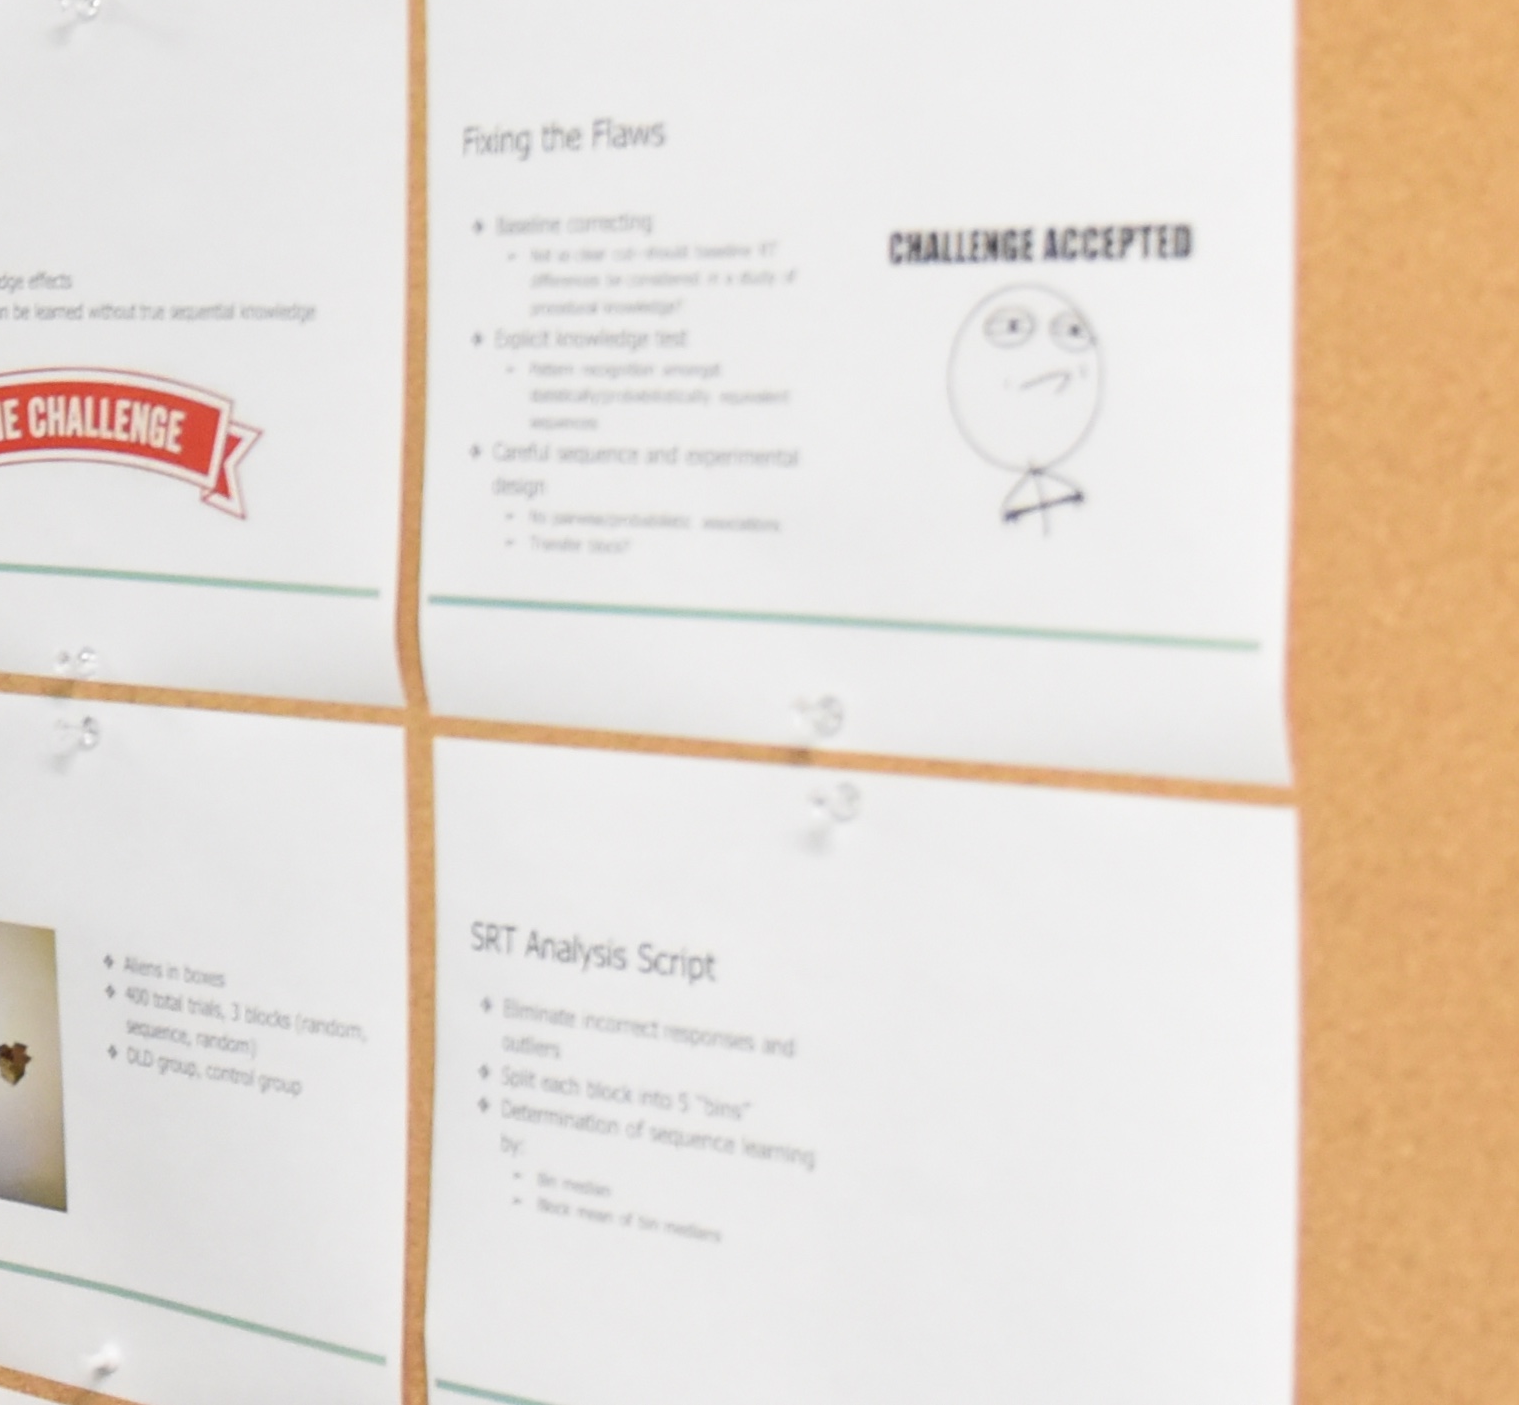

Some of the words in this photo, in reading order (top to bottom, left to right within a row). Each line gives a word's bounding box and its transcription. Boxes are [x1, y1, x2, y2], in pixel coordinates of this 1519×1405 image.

[462, 126, 533, 161] Fixing
[541, 122, 584, 153] the
[591, 117, 667, 149] Flaws
[888, 228, 1034, 265] CHALLENGE
[1042, 224, 1193, 262] ACCEPTED
[27, 395, 186, 454] CHALLENGE
[470, 921, 516, 954] SRT
[525, 931, 628, 971] Analysis
[637, 943, 717, 984] Script
